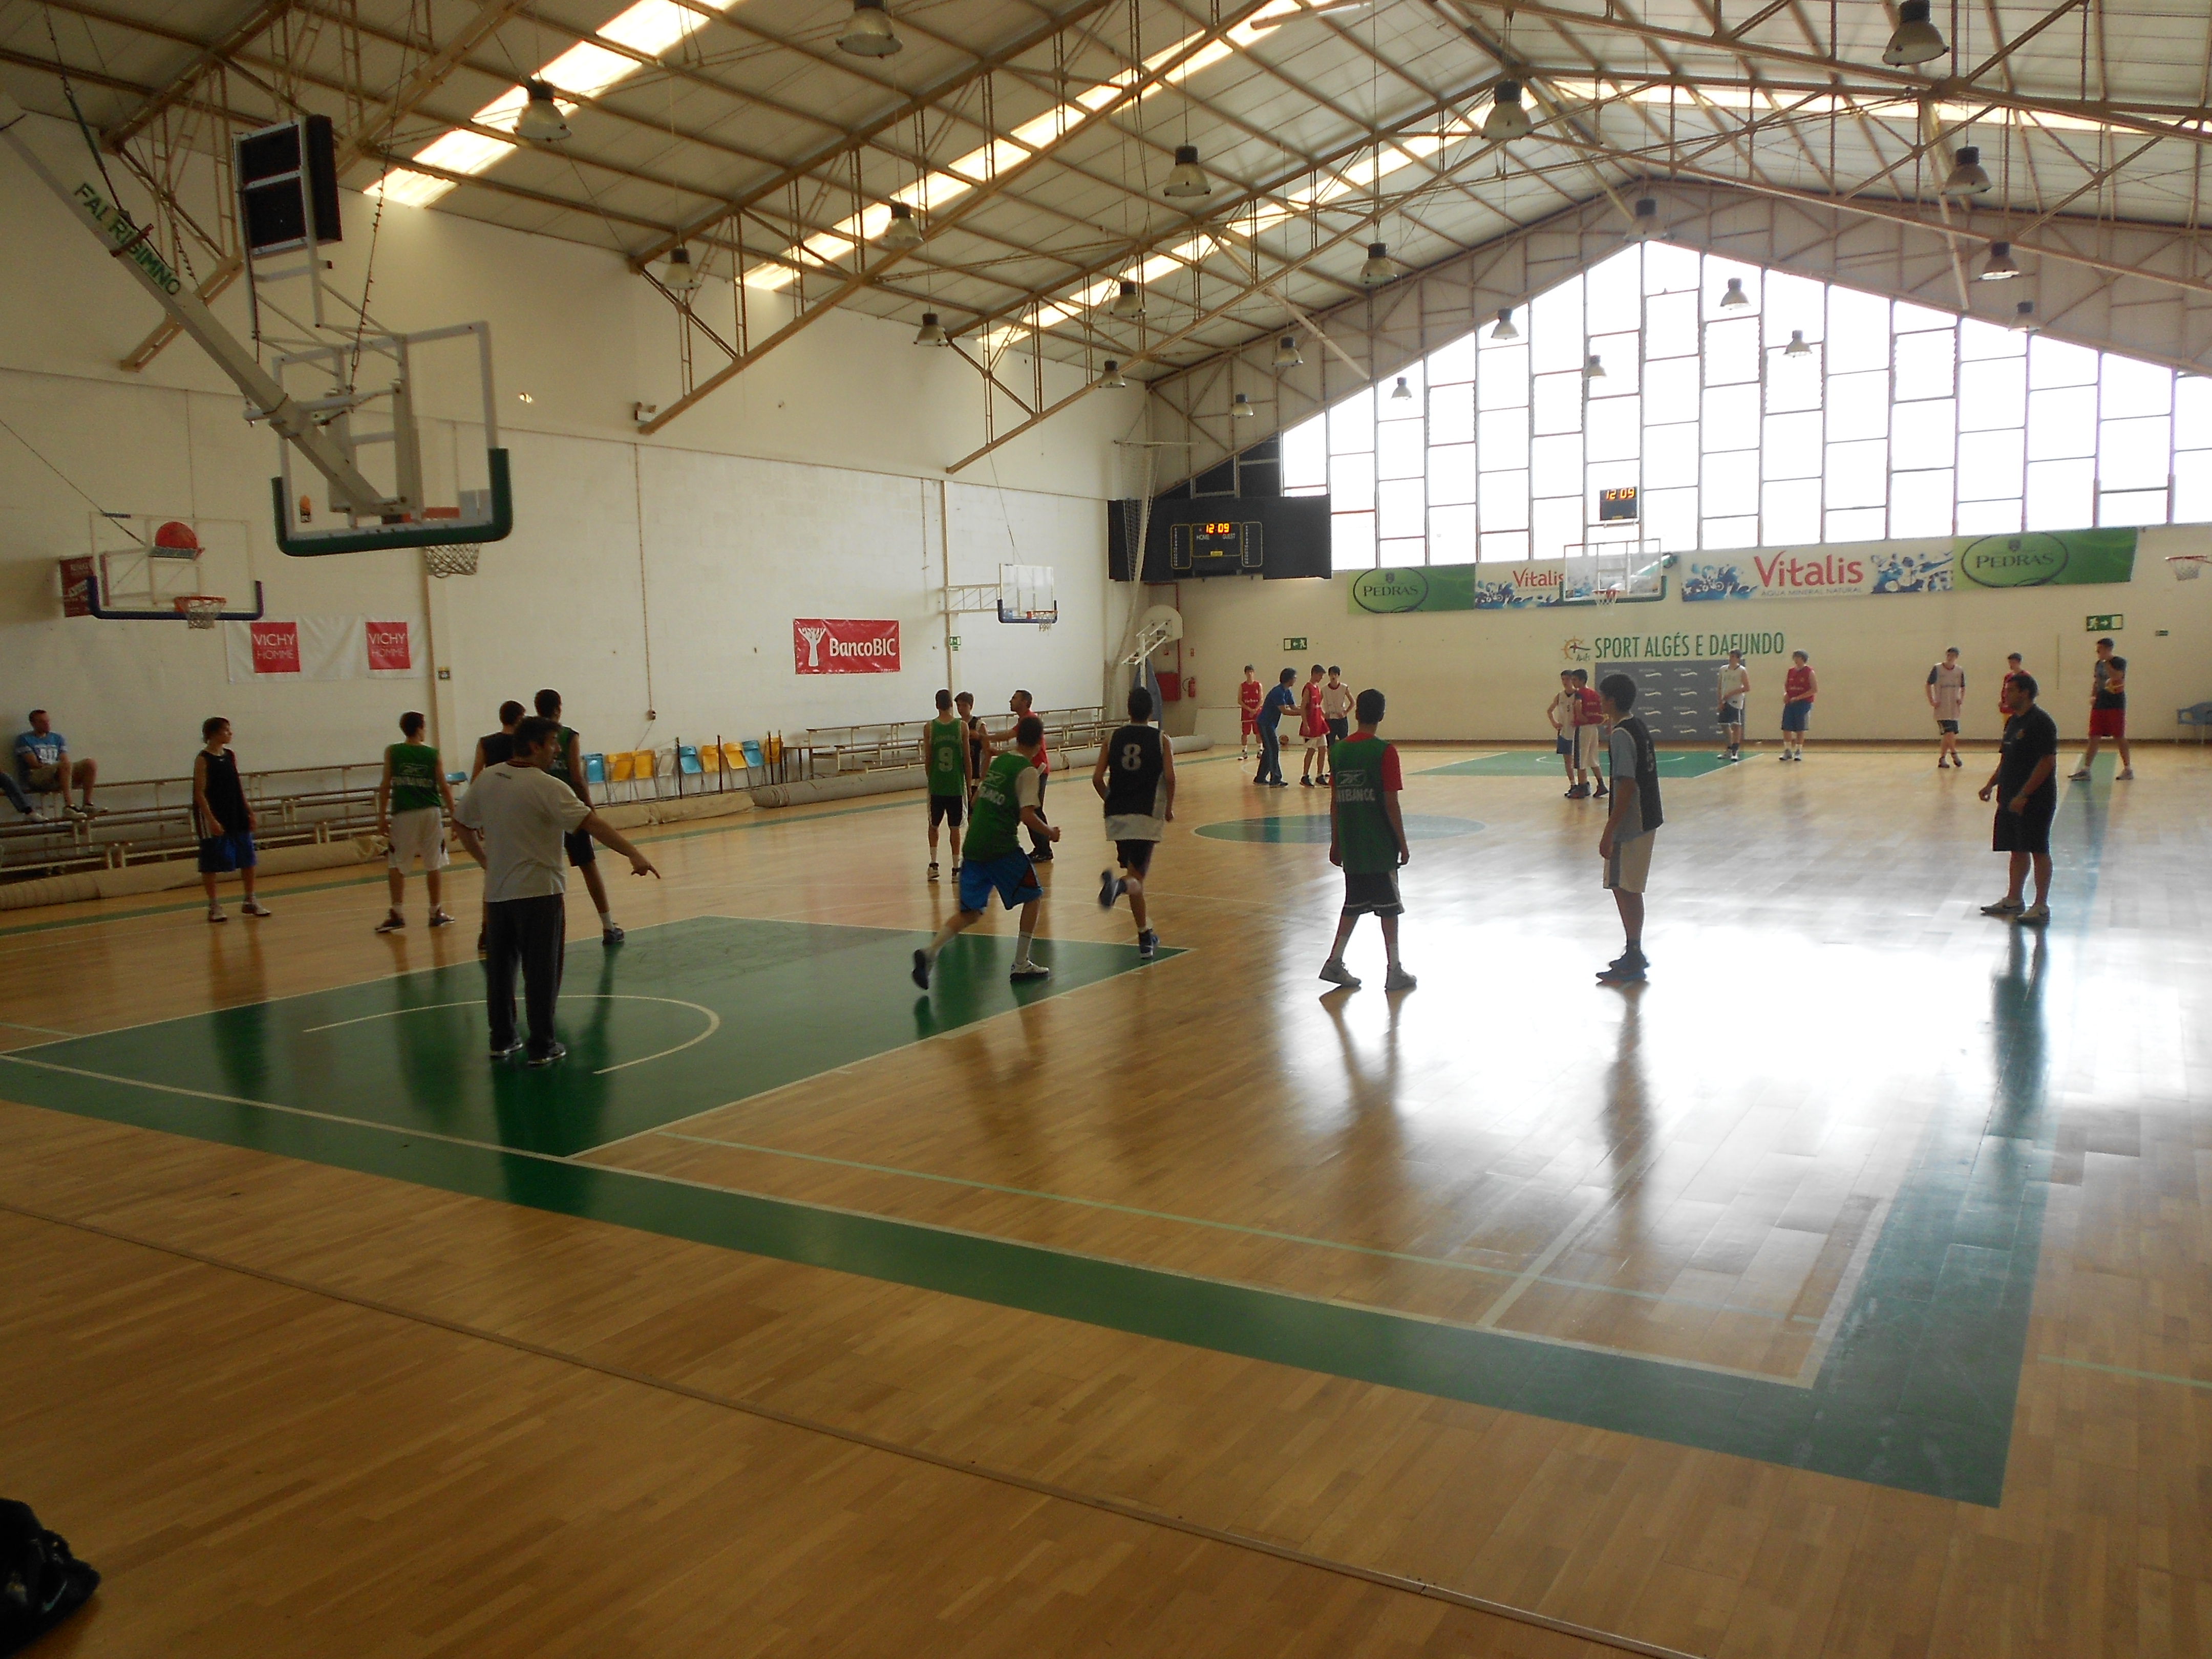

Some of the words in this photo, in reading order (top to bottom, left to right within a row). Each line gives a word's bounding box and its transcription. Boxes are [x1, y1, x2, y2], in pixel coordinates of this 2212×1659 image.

[1977, 553, 2054, 568] PEDRAS
[1753, 550, 1863, 587] Vitalis
[1364, 585, 1418, 597] PEDRAS
[253, 634, 294, 646] VICHY
[369, 633, 405, 645] VICHY
[1595, 637, 1640, 658] SPORT
[1644, 632, 1689, 657] ALGÉS
[1696, 635, 1703, 655] E
[371, 648, 405, 657] HOMME
[830, 638, 896, 656] BancoBIC
[257, 650, 294, 660] HOMME
[939, 747, 953, 772] 9
[1121, 743, 1142, 770] 8
